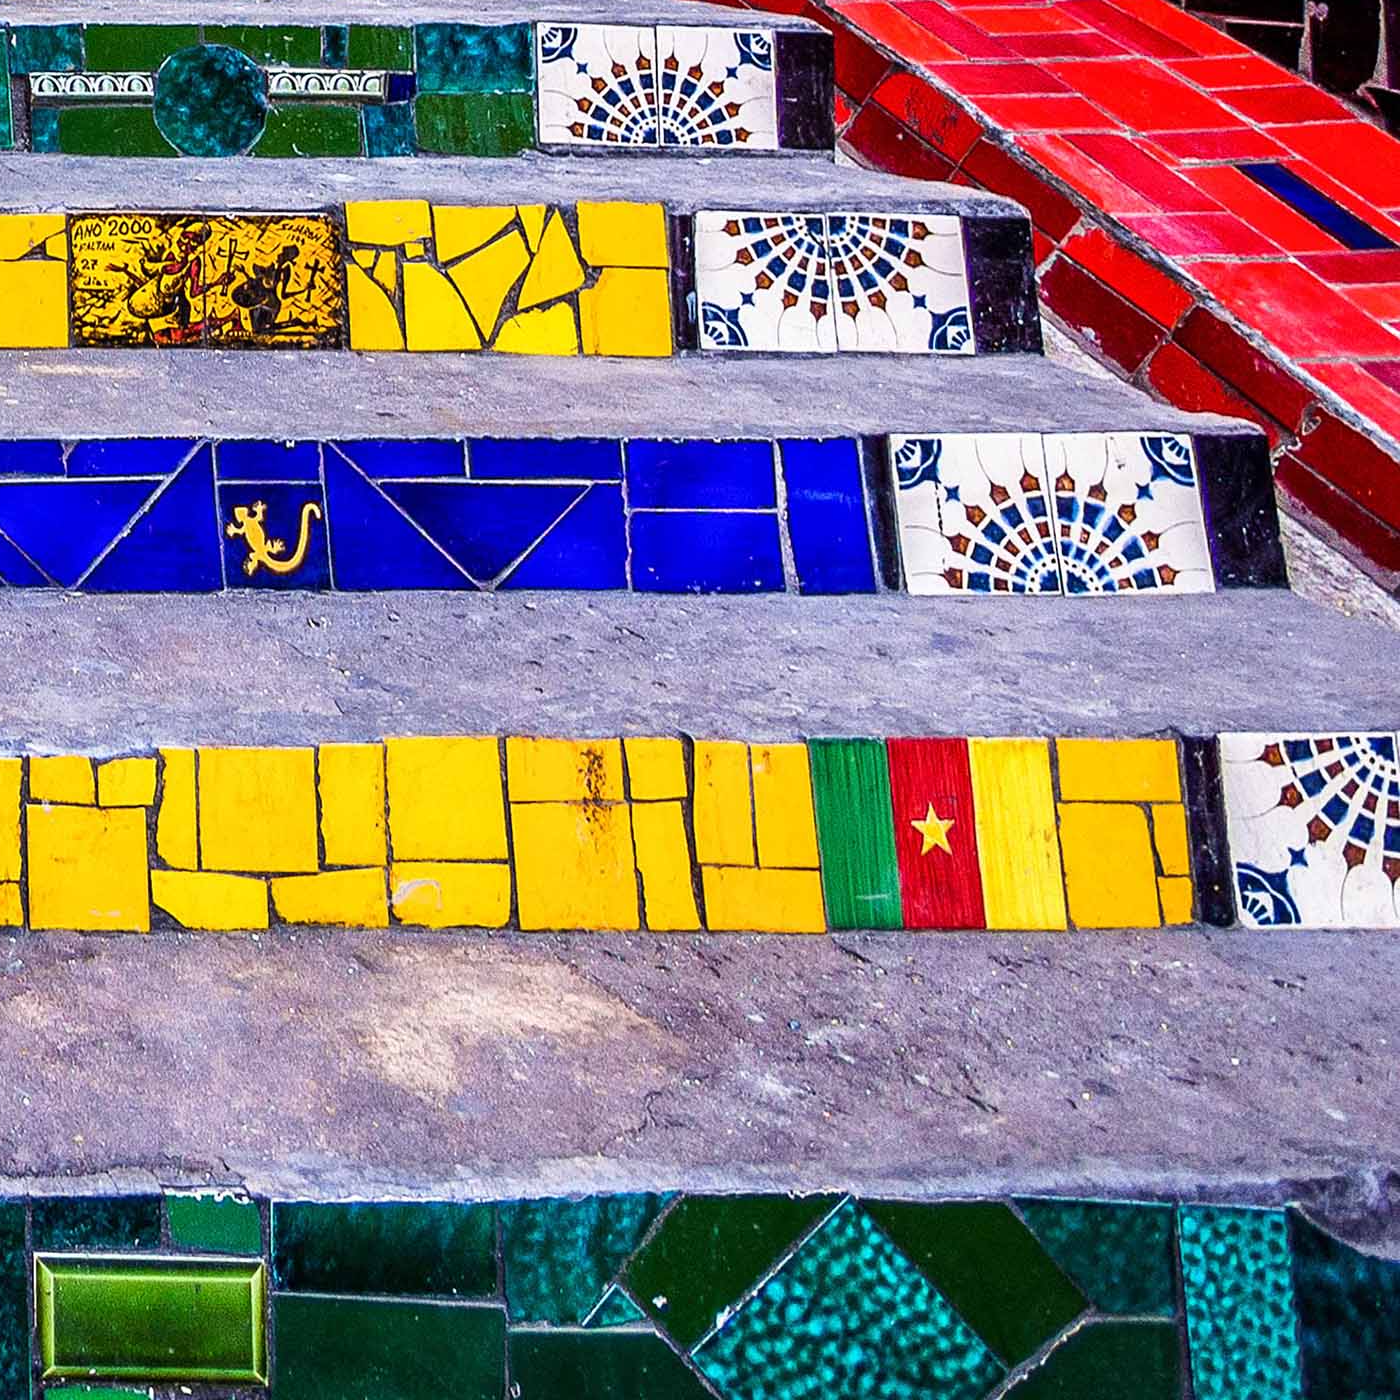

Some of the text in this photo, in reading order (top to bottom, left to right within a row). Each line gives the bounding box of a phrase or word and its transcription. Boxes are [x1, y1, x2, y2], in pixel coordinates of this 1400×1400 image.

[74, 220, 152, 240] ANO 2000
[81, 259, 98, 270] 27
